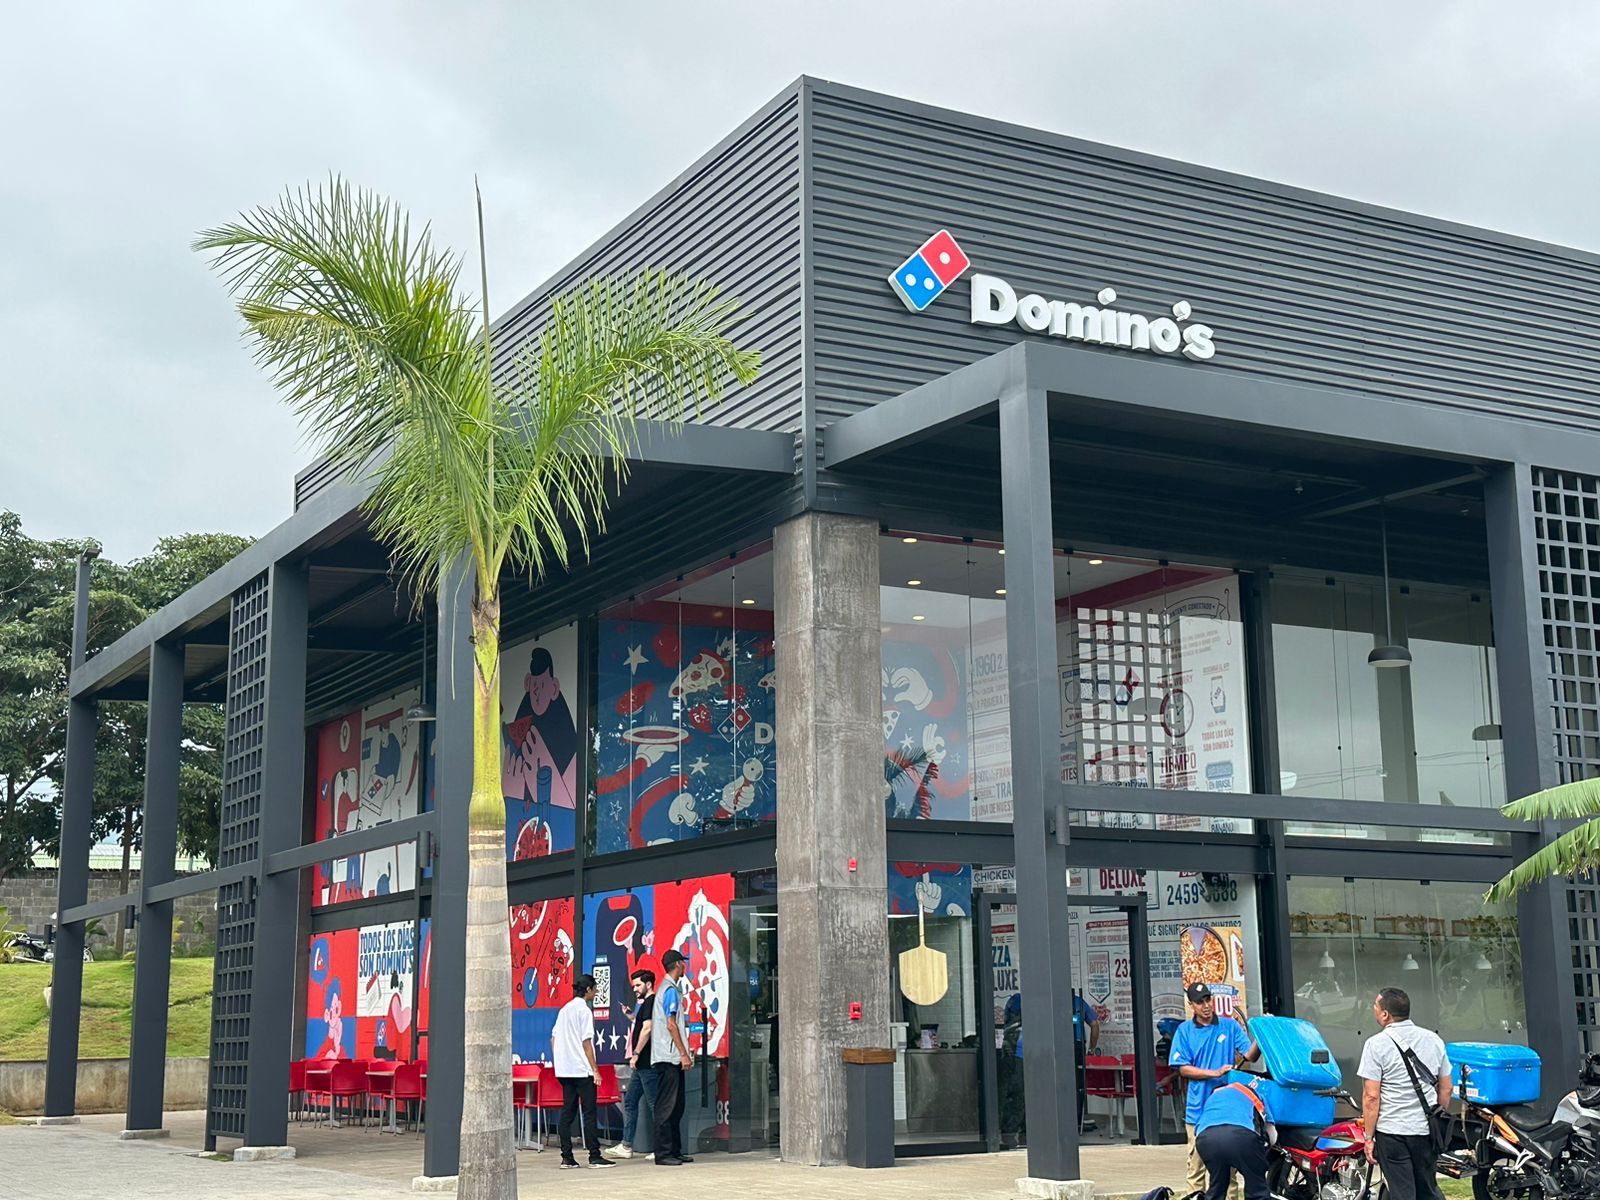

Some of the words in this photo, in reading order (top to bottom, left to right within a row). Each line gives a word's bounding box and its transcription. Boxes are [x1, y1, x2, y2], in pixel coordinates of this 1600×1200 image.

[970, 273, 1216, 361] Domino's
[1061, 768, 1078, 781] ITES
[1159, 752, 1197, 775] TIEMPO
[974, 869, 1014, 882] CHICKEN
[1167, 882, 1200, 906] 2459
[361, 932, 381, 954] TODOS
[383, 929, 395, 952] LOS
[397, 923, 414, 950] DÍAS
[359, 954, 374, 978] SON
[376, 950, 414, 976] DOMINO'S
